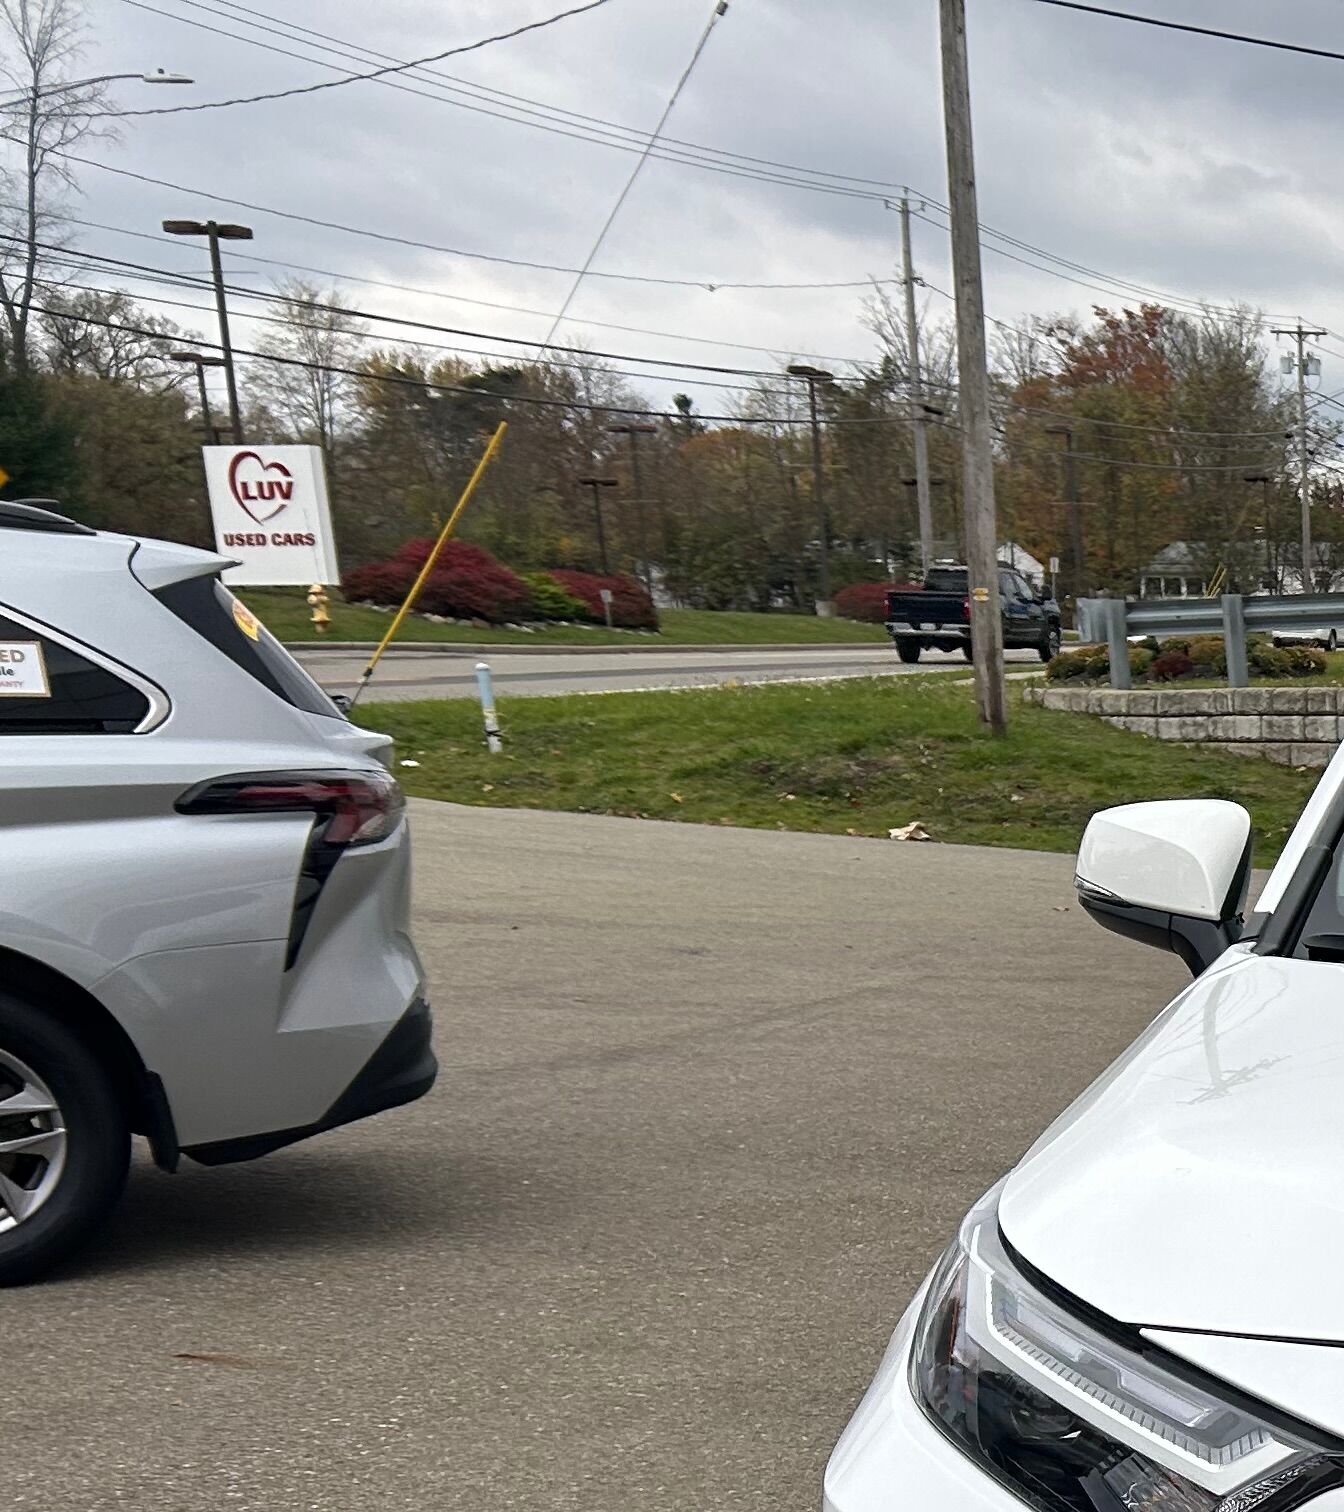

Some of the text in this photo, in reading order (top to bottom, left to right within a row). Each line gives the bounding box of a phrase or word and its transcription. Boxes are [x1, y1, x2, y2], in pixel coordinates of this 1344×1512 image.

[240, 481, 293, 500] LUV
[223, 533, 316, 547] USED CARS
